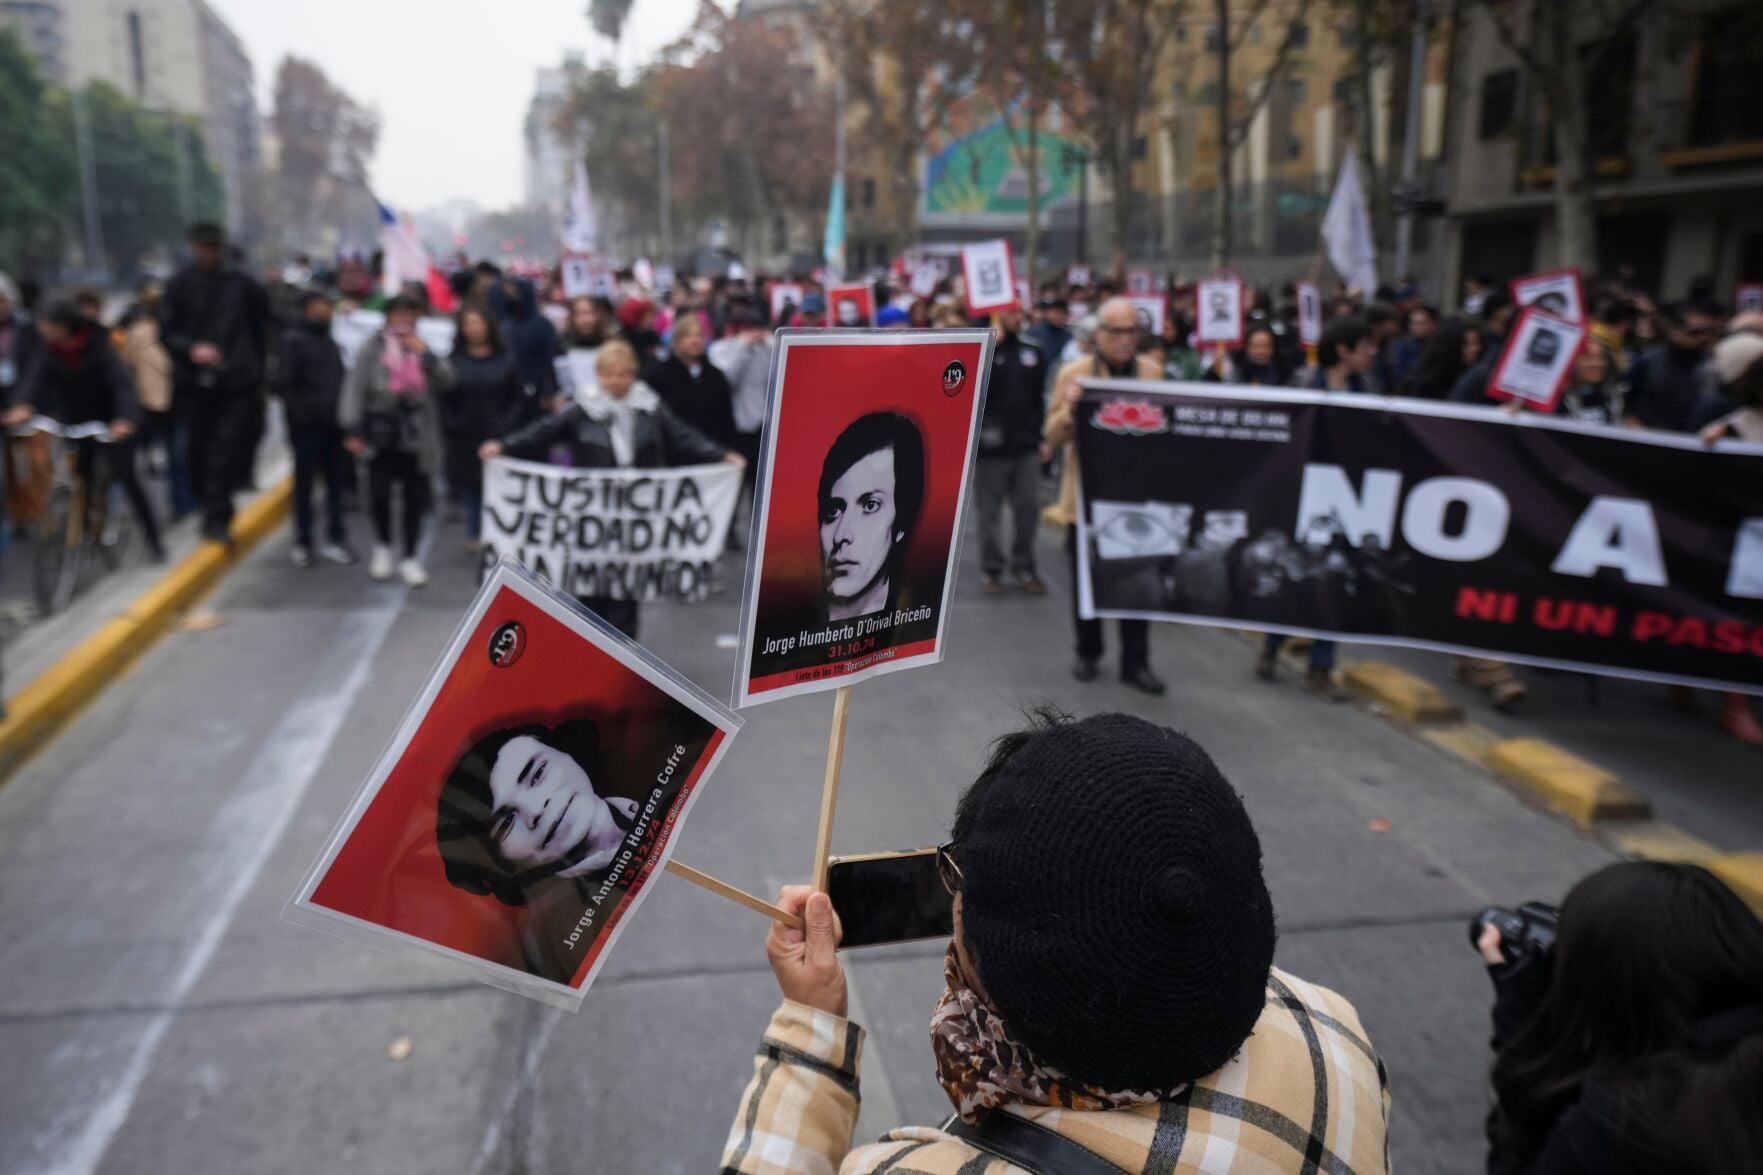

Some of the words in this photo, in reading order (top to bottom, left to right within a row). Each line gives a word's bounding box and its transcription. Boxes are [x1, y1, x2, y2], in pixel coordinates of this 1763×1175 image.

[484, 505, 654, 550] VERDAD
[662, 514, 711, 547] NO
[1295, 463, 1511, 562] NO
[1551, 495, 1669, 588] A
[762, 637, 795, 655] Jorge
[799, 625, 854, 648] Humberto
[894, 605, 931, 625] Briceño
[1456, 587, 1517, 622] NI
[1532, 598, 1616, 636] UN
[828, 637, 875, 658] 31.10.74
[563, 907, 596, 950] Jorge
[592, 852, 632, 906] Antonio
[627, 788, 662, 847] Herrera
[657, 744, 686, 786] Cofré
